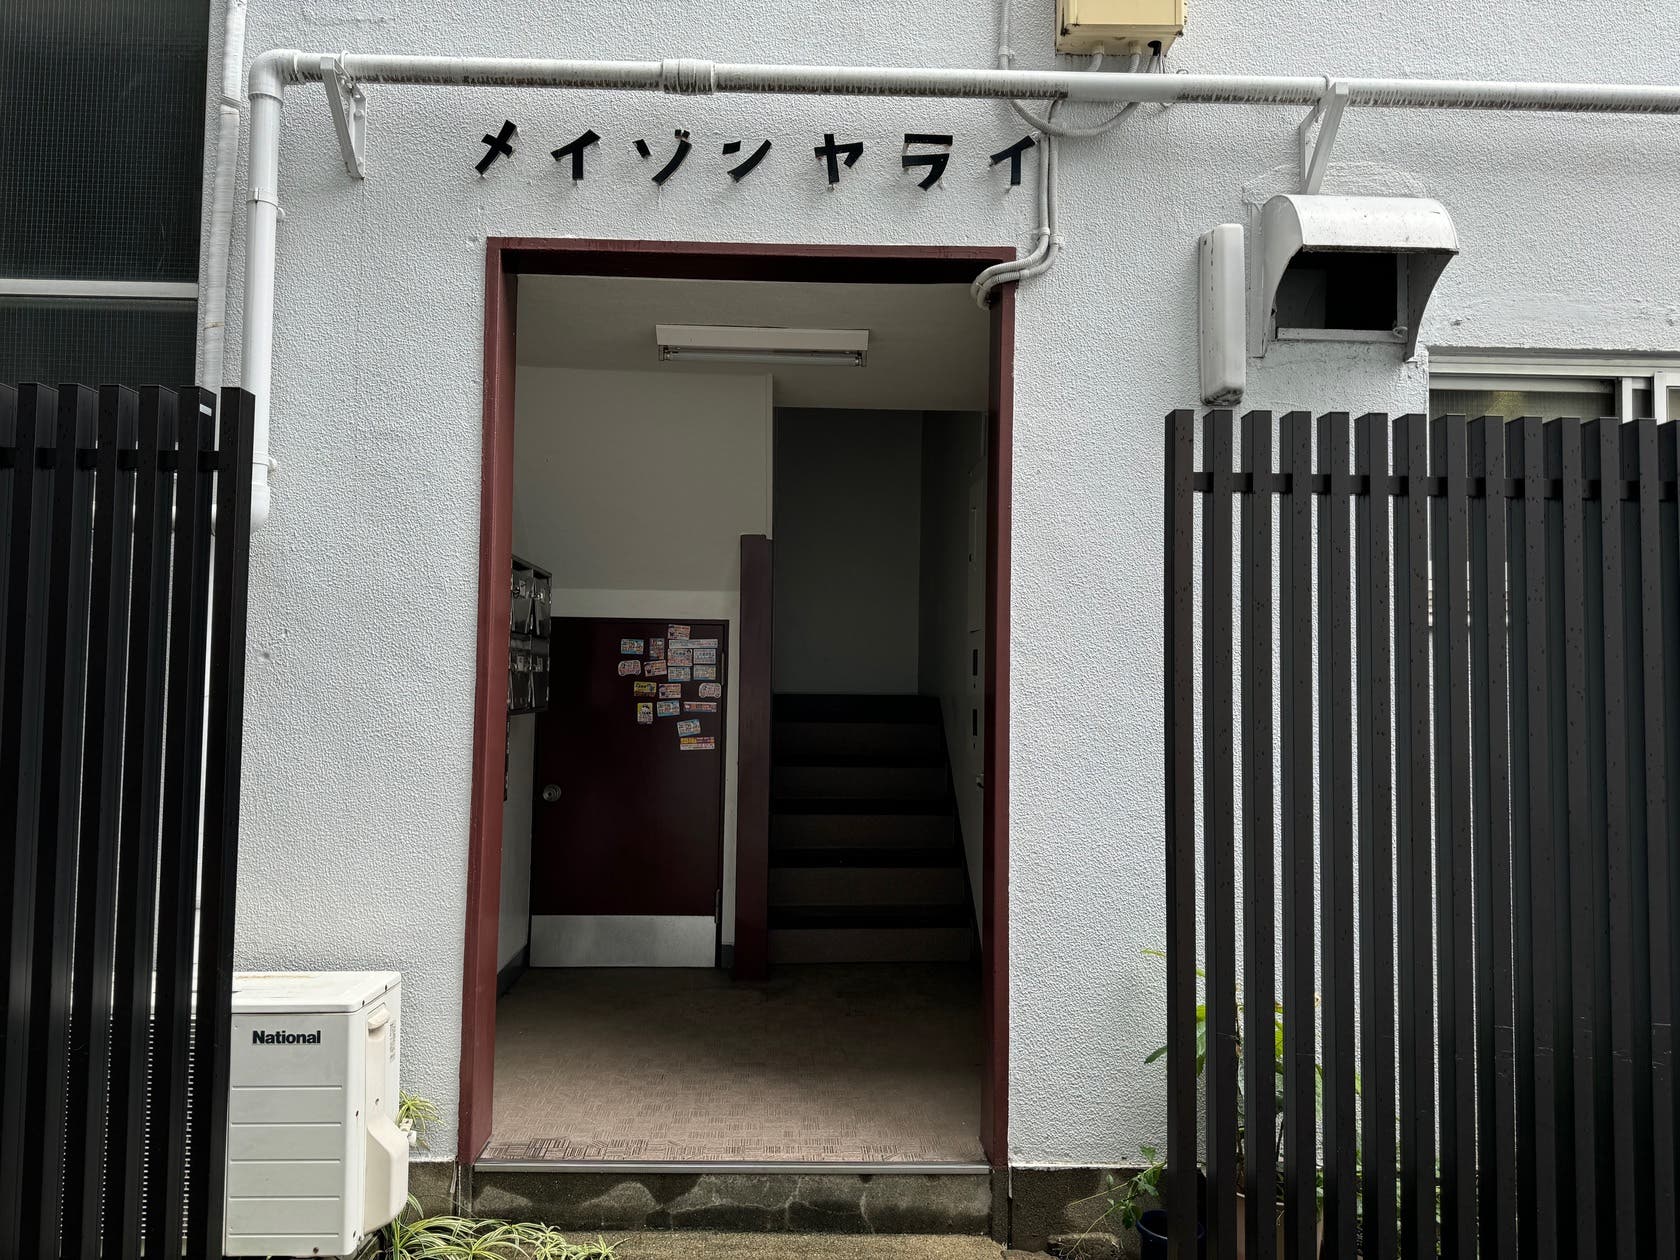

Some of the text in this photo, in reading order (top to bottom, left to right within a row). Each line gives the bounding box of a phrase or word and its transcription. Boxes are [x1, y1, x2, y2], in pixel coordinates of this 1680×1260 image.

[474, 119, 1037, 192] メイゾンヤライ
[252, 1030, 321, 1044] National
